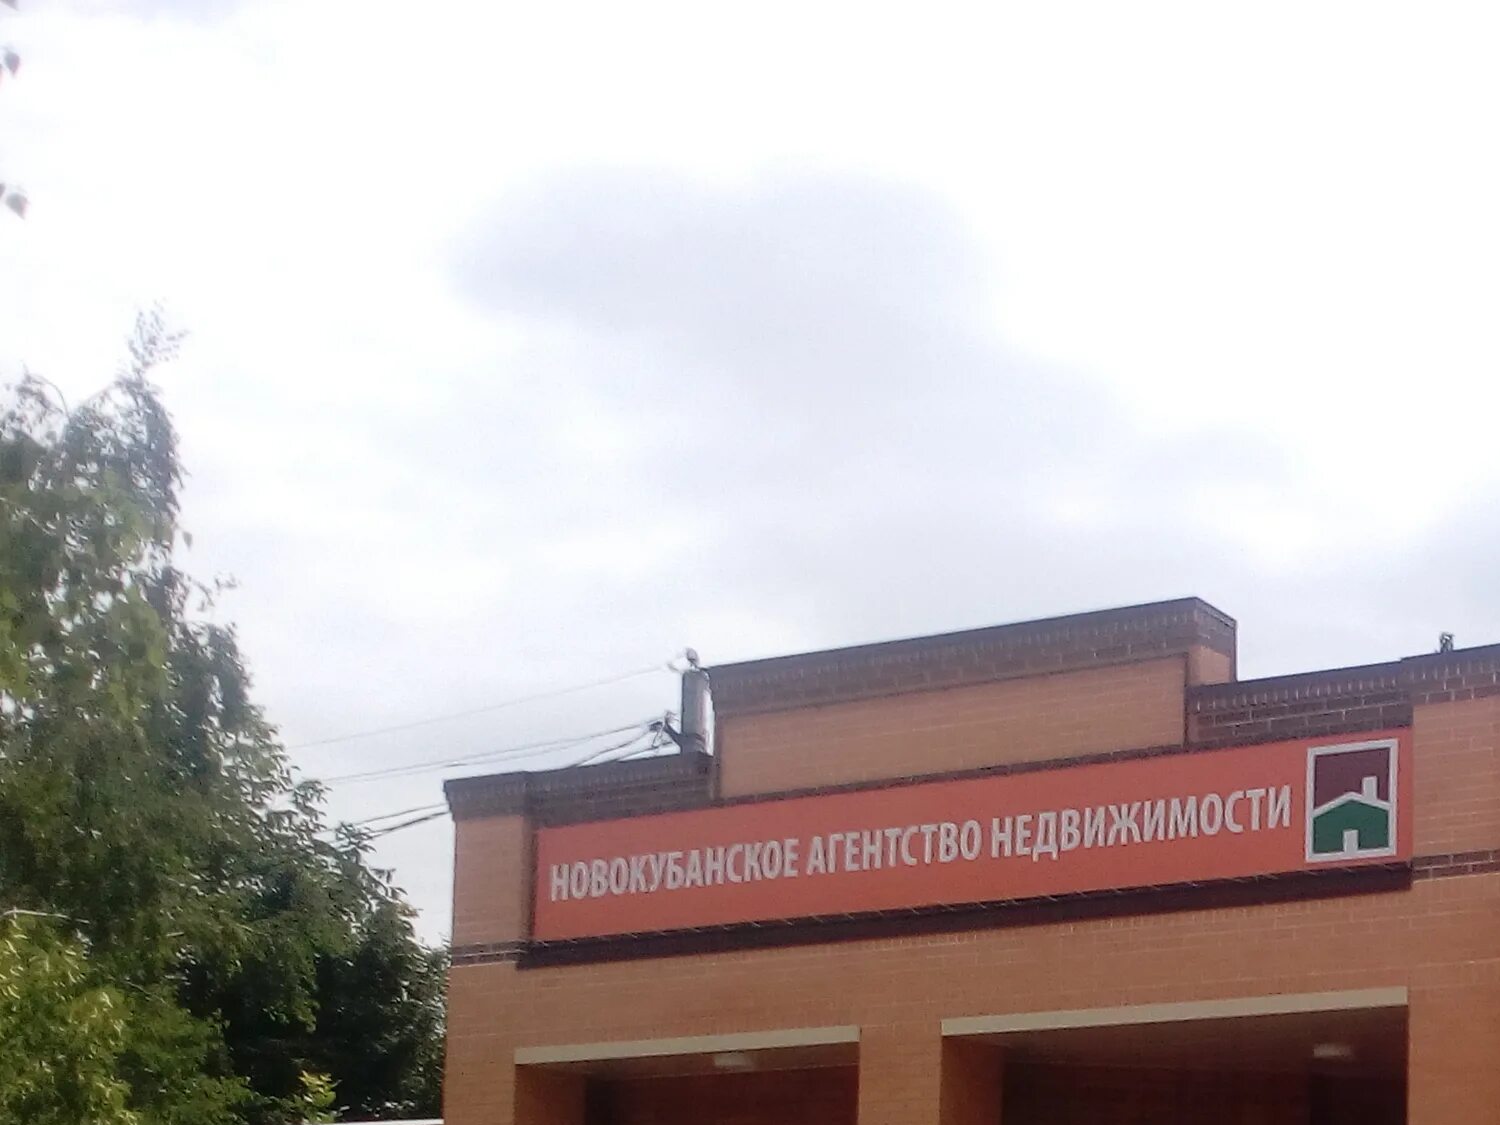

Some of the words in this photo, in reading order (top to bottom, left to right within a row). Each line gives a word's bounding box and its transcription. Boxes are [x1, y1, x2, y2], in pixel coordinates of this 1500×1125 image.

[551, 838, 799, 901] НОВОКУБАНСКОЕ
[806, 819, 982, 875] АГЕНТСТВО
[991, 785, 1291, 862] НЕДВИЖИМОСТИ
